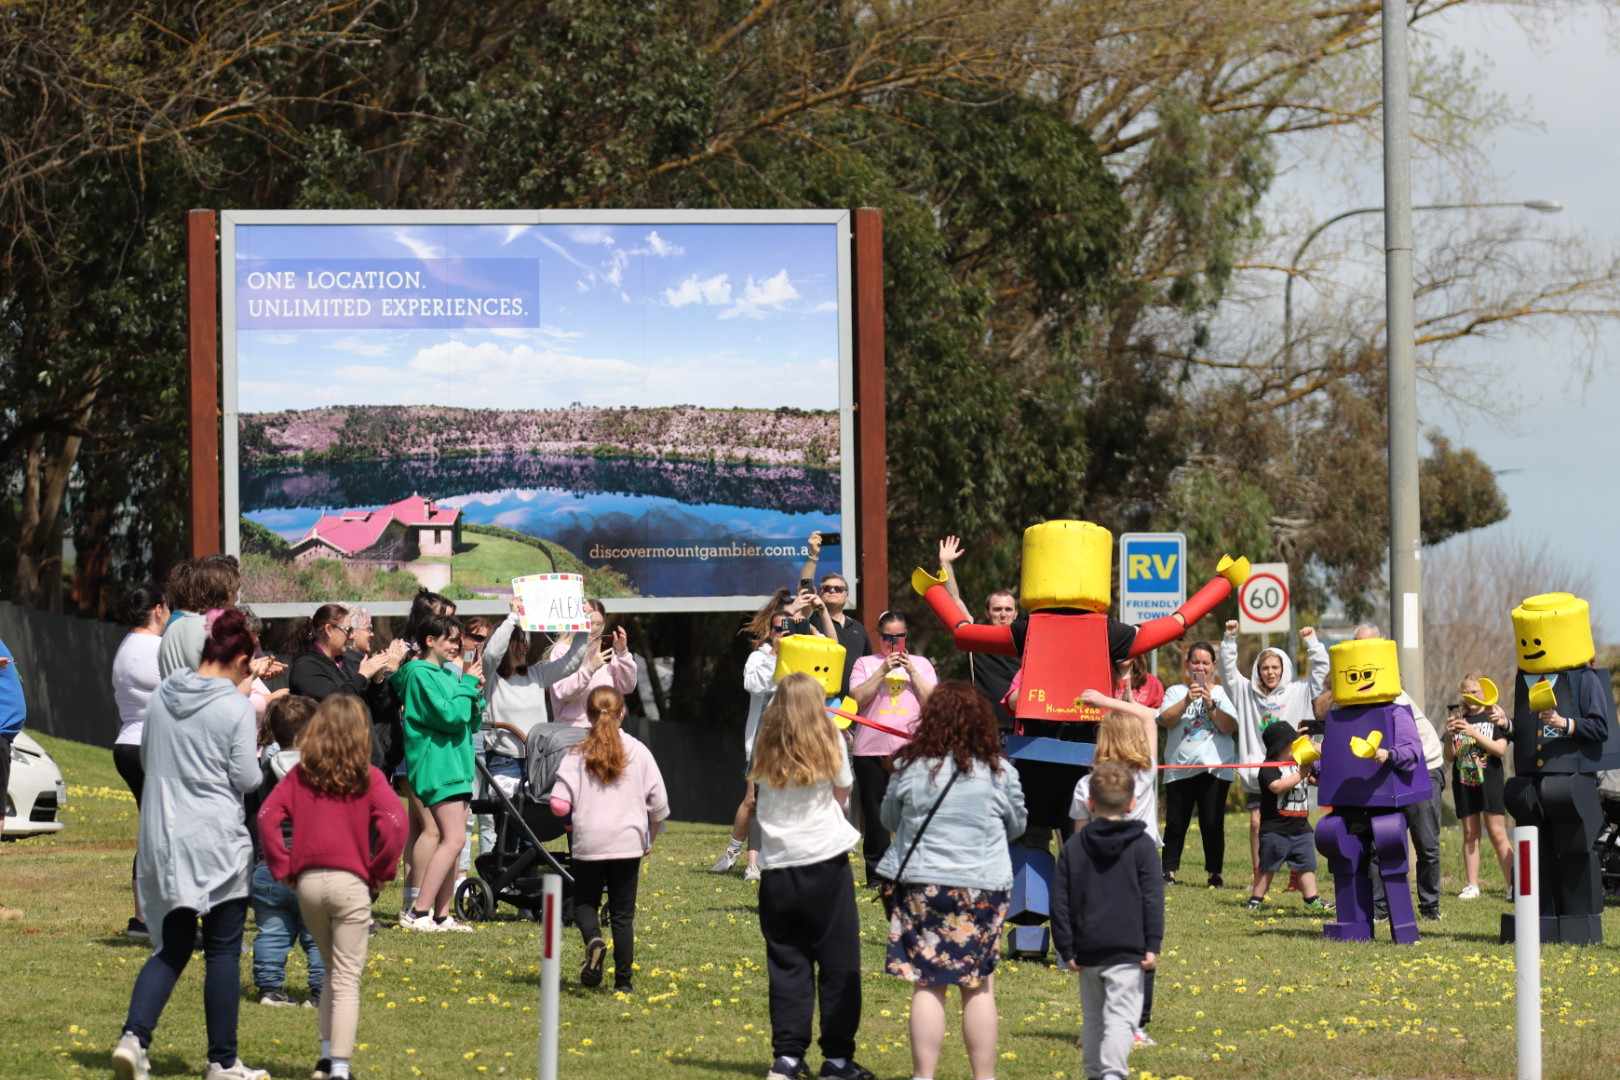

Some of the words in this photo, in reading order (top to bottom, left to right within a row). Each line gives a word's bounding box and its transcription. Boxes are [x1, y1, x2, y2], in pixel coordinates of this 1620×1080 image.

[247, 271, 295, 290] ONE
[307, 271, 427, 290] LOCATION.
[248, 299, 372, 318] UNLIMITED
[381, 298, 529, 317] EXPERIENCES.
[589, 542, 811, 561] discovermountgambier.com.a
[1128, 553, 1178, 580] RV
[1126, 600, 1179, 608] FRIENDLY
[1250, 587, 1279, 609] 60
[1028, 688, 1046, 702] FB
